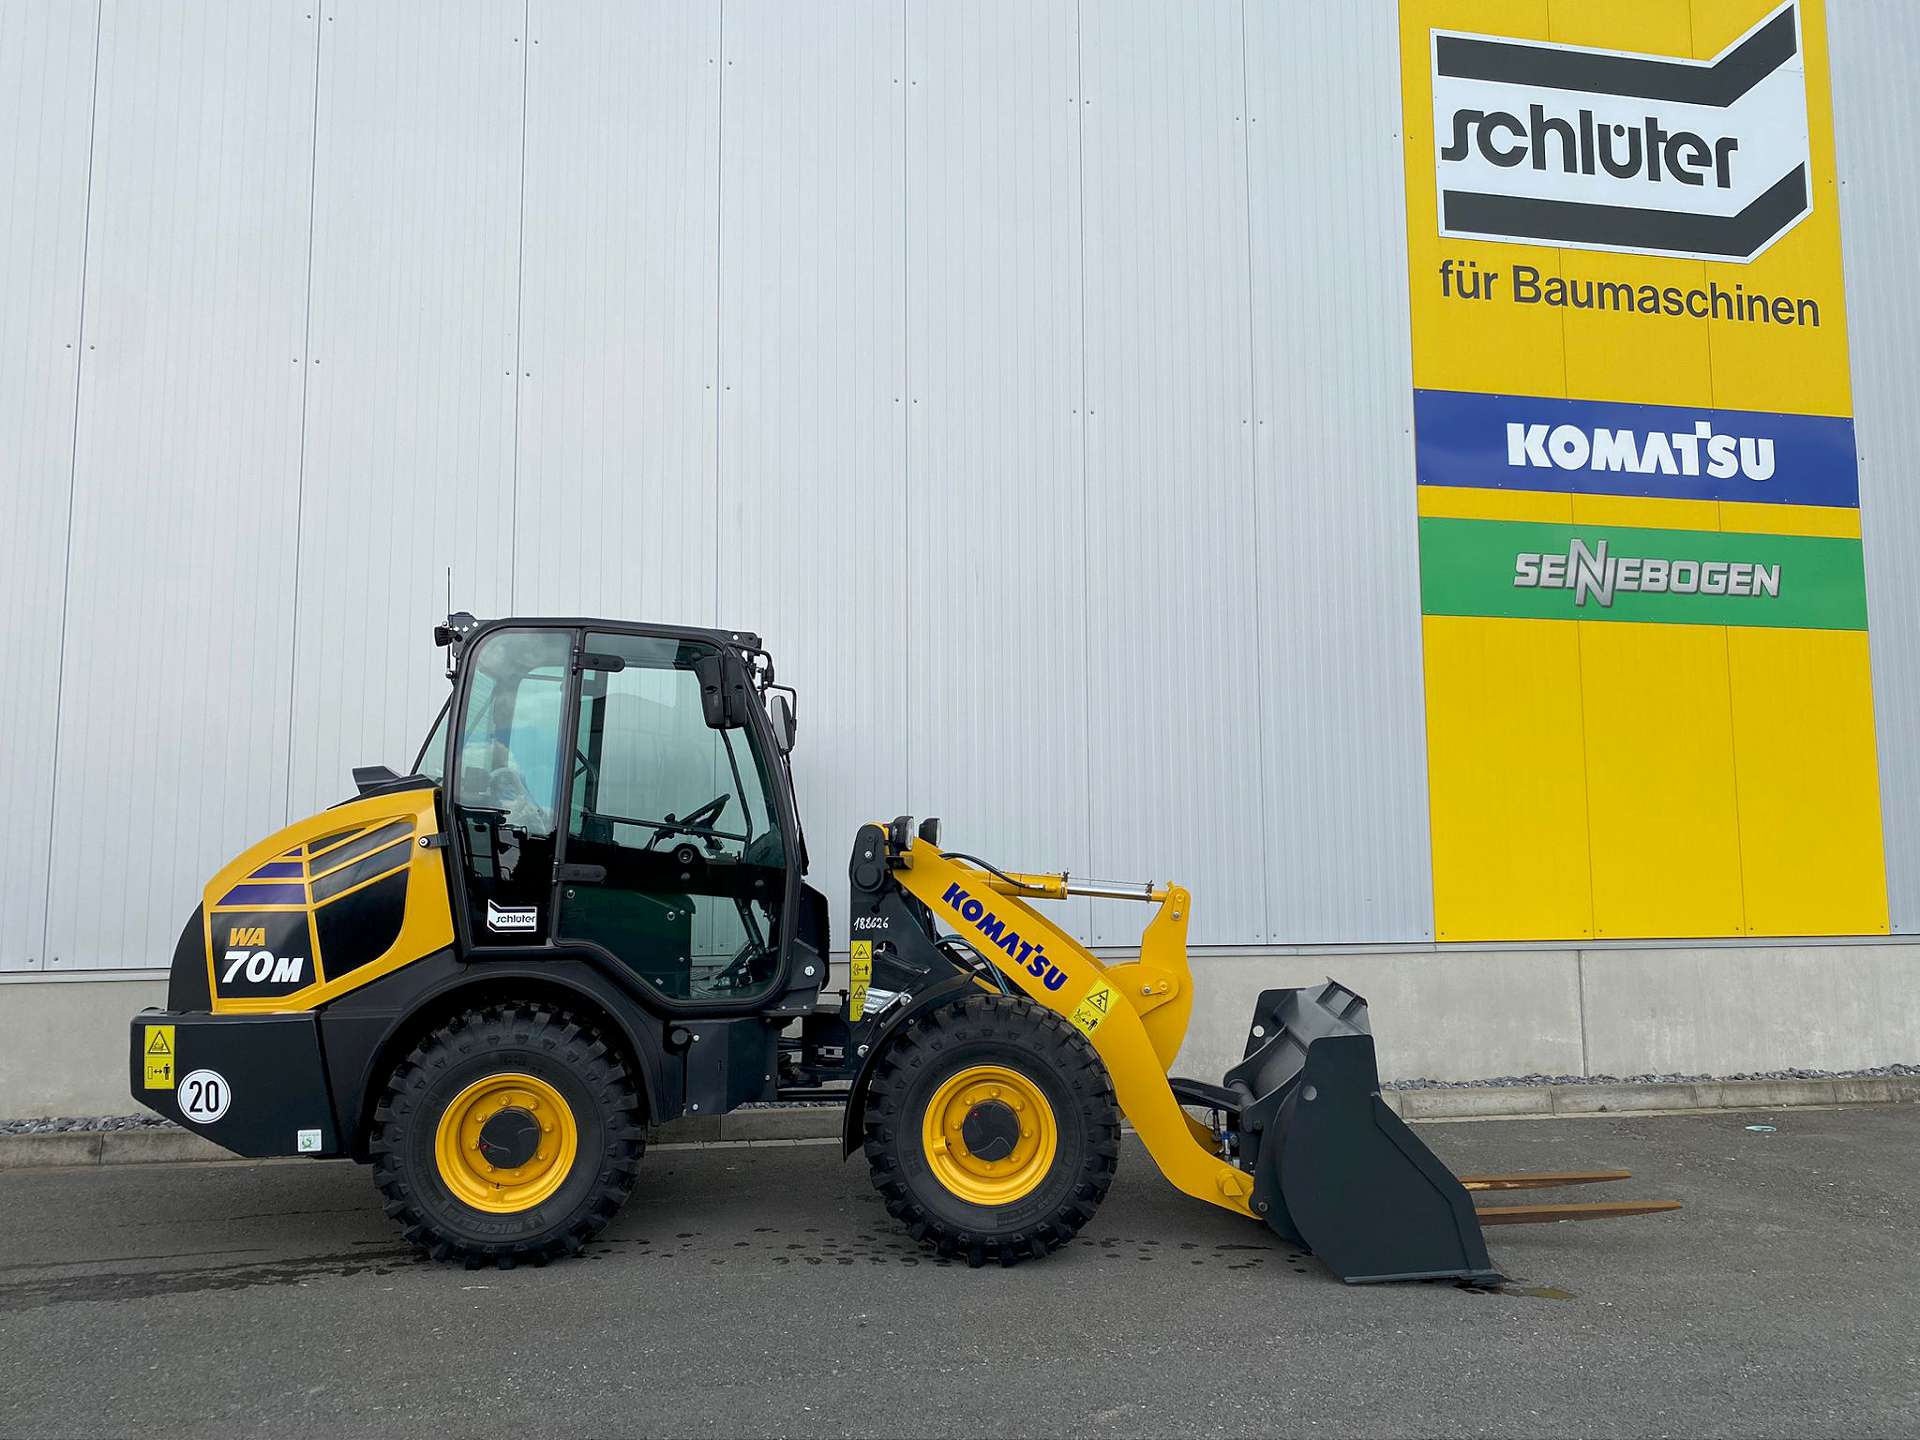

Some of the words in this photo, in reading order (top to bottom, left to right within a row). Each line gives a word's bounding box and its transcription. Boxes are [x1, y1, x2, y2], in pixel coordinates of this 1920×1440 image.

[1441, 103, 1738, 188] schlüter
[1439, 260, 1498, 301] für
[1513, 265, 1820, 327] Baumaschinen
[1506, 420, 1776, 481] KOMATSU
[1513, 538, 1780, 607] SENNEBOGEN
[229, 928, 266, 946] WA
[853, 917, 889, 931] 188626
[941, 882, 1069, 991] KOMATSU
[222, 951, 304, 983] 70M
[189, 1080, 220, 1113] 20
